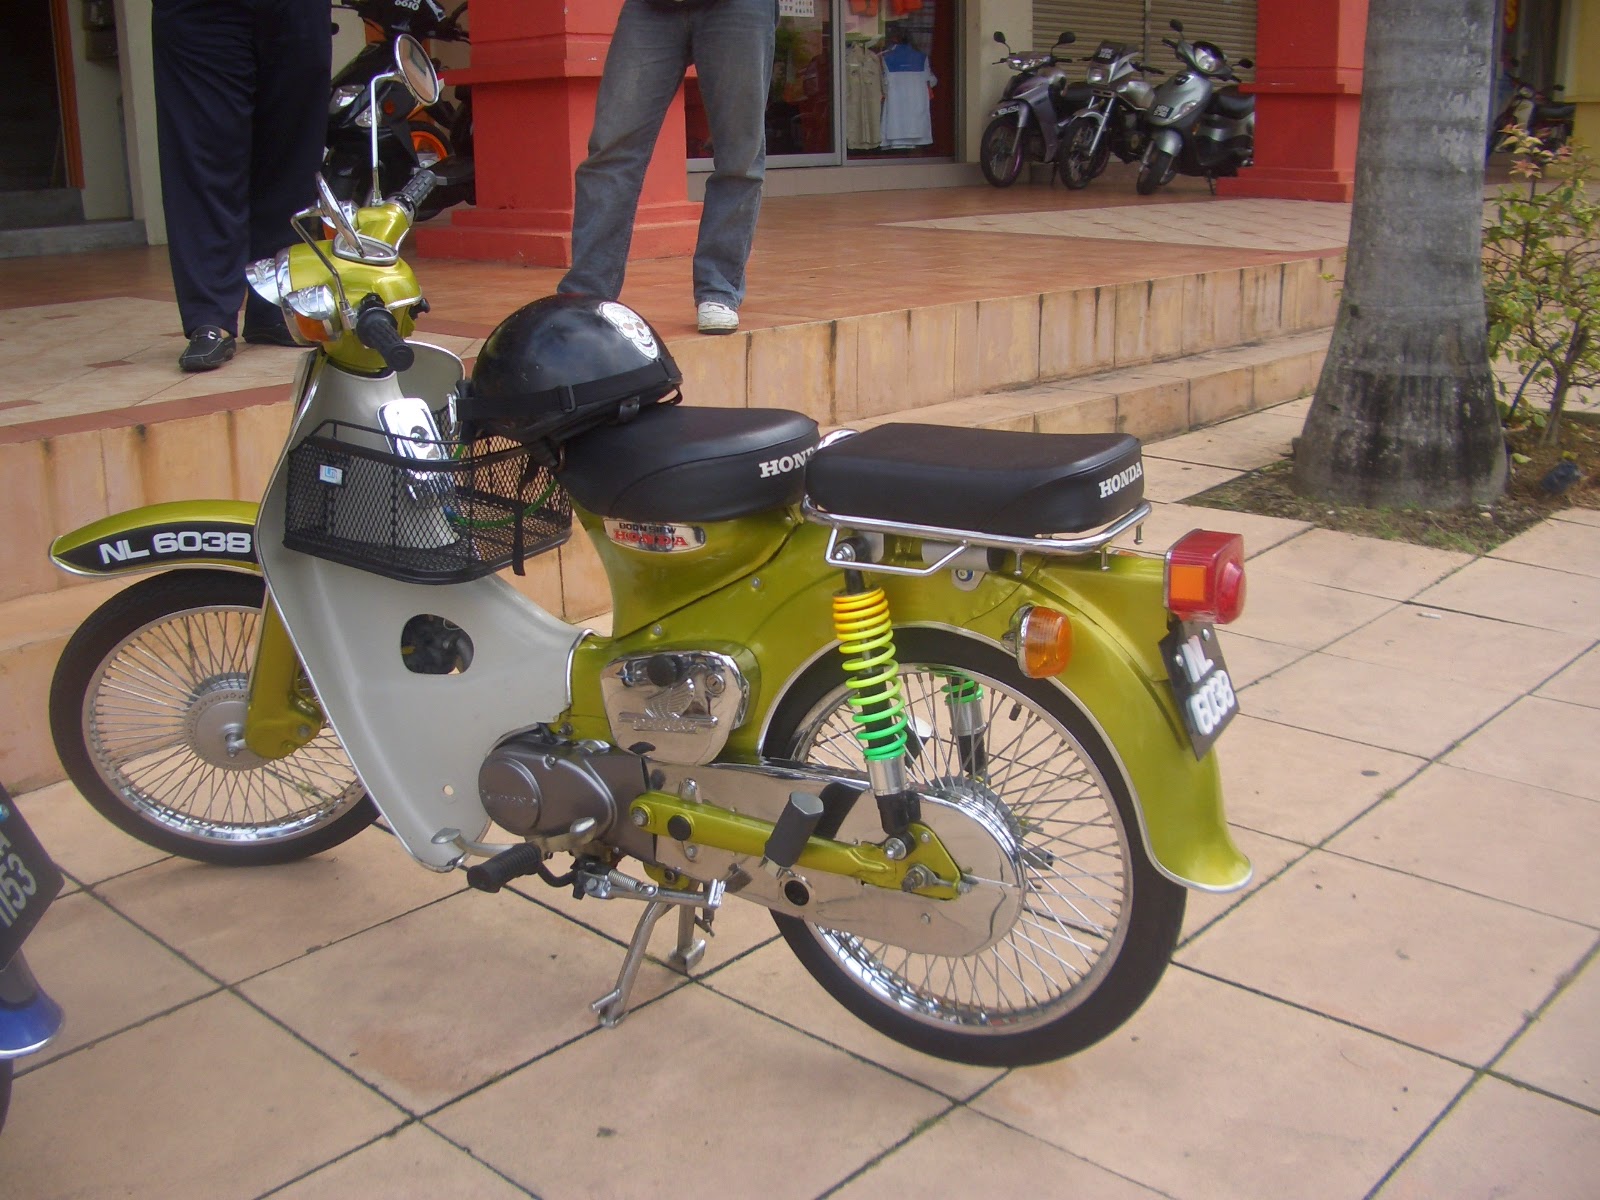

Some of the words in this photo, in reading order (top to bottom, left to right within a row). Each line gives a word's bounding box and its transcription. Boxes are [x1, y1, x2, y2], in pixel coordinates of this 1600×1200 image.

[758, 446, 815, 479] HON
[1098, 461, 1143, 499] HONDA
[98, 539, 150, 565] NL
[153, 531, 252, 554] 6038
[614, 530, 689, 547] HONDA
[1181, 634, 1215, 684] NL
[1188, 669, 1236, 736] 6038
